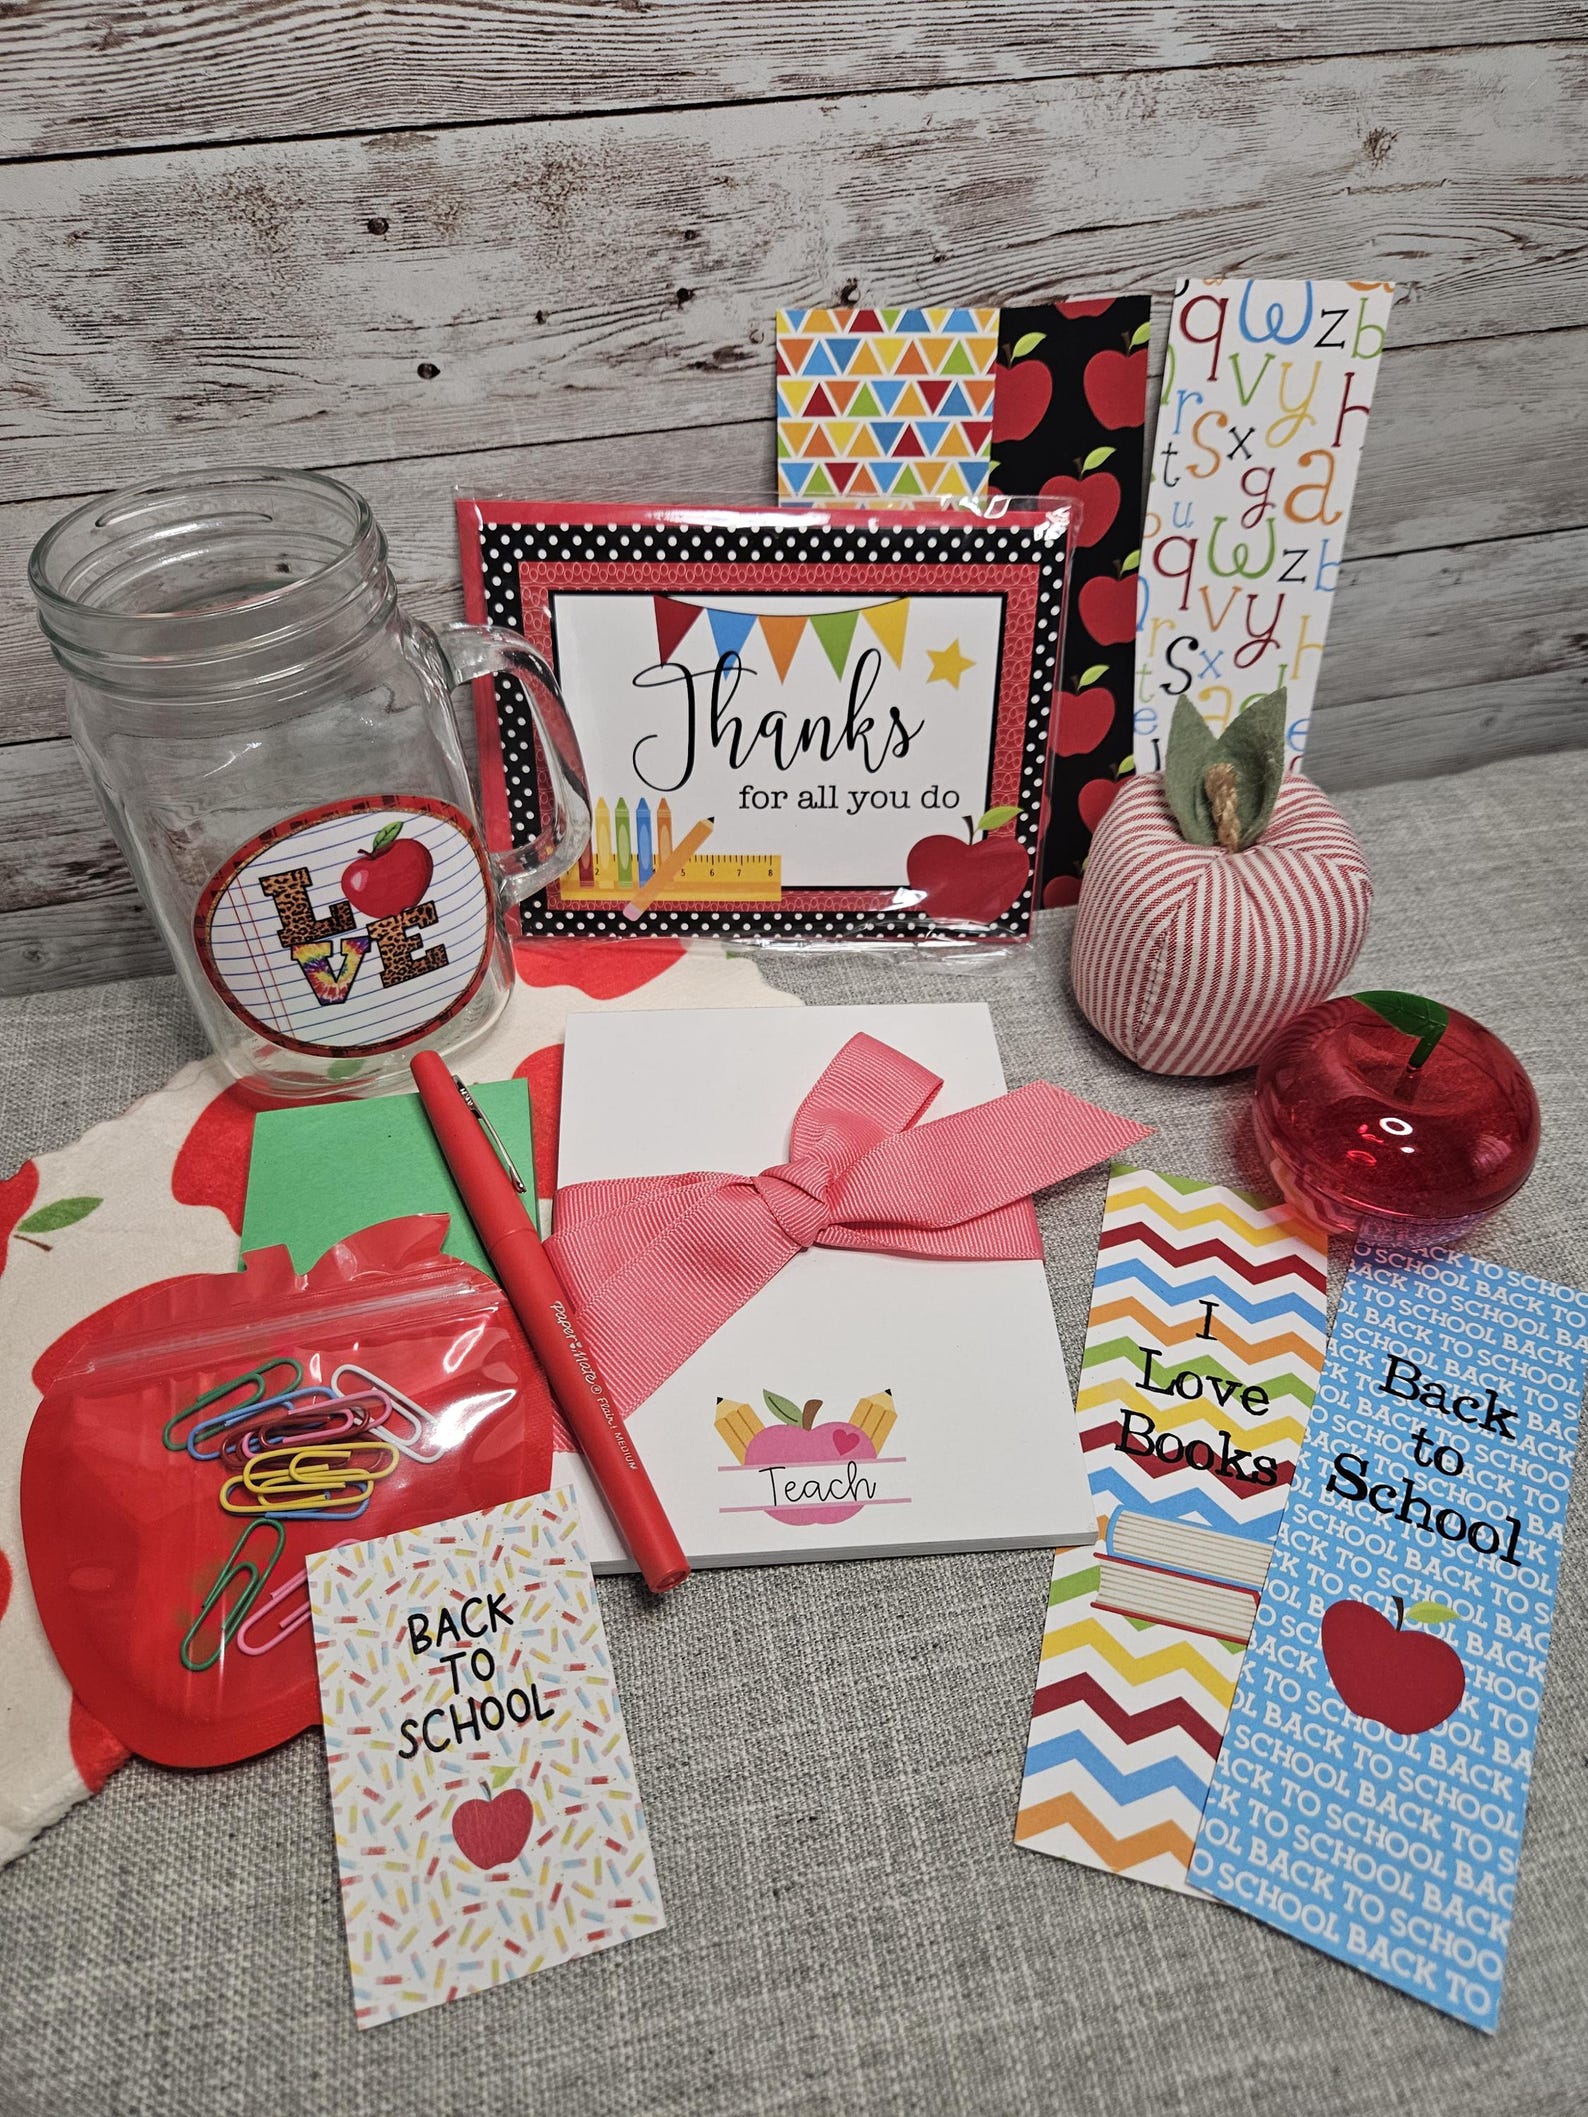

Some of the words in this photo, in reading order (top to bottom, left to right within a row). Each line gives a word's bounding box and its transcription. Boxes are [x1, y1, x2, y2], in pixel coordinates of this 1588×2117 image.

[1179, 294, 1229, 382] q
[1313, 308, 1350, 349] z
[1351, 297, 1386, 359] b
[1172, 388, 1204, 435] r
[1228, 352, 1276, 406] v
[1265, 360, 1322, 448] y
[1161, 441, 1181, 488] t
[1226, 426, 1256, 461] x
[1171, 501, 1194, 529] u
[1283, 449, 1343, 526] a
[1153, 535, 1198, 611] q
[1277, 549, 1309, 584] z
[1147, 617, 1176, 659] r
[1198, 585, 1243, 633] v
[1233, 592, 1285, 669] y
[1135, 663, 1155, 703] t
[1197, 650, 1224, 679] x
[632, 648, 925, 792] Thanks
[1133, 707, 1158, 735] e
[738, 785, 788, 810] for
[797, 785, 839, 810] all
[847, 789, 911, 816] you
[920, 785, 960, 810] do
[680, 869, 686, 877] 5
[709, 869, 715, 877] 6
[737, 869, 742, 877] 7
[768, 869, 774, 877] 8
[1375, 1249, 1469, 1291] SCHOOL
[1475, 1280, 1544, 1315] BACK
[1551, 1304, 1585, 1328] TO
[1470, 1257, 1503, 1279] TO
[1195, 1299, 1219, 1341] I
[1363, 1284, 1395, 1307] TO
[1399, 1300, 1496, 1344] SCHOOL
[1502, 1333, 1573, 1371] BACK
[1415, 1281, 1447, 1304] TO
[1451, 1296, 1549, 1340] SCHOOL
[1135, 1346, 1271, 1417] Love
[1341, 1323, 1438, 1370] SCHOOL
[1444, 1358, 1515, 1398] BACK
[1523, 1386, 1558, 1411] TO
[1355, 1372, 1388, 1397] TO
[1364, 1307, 1432, 1345] BACK
[1439, 1334, 1473, 1358] TO
[1477, 1350, 1580, 1396] SCHOOL
[1357, 1397, 1428, 1434] BACK
[1435, 1426, 1470, 1454] TO
[1378, 1353, 1519, 1440] Back
[1114, 1408, 1278, 1487] Books
[1411, 1427, 1465, 1477] to
[758, 1460, 877, 1507] Teach
[1325, 1453, 1523, 1567] School
[1374, 1453, 1409, 1482] TO
[1413, 1472, 1517, 1525] SCHOOL
[1522, 1485, 1560, 1513] TO
[1293, 1504, 1398, 1562] SCHOOL
[1405, 1547, 1482, 1597] BACK
[1491, 1582, 1529, 1613] TO
[1319, 1484, 1392, 1531] BACK
[1401, 1522, 1436, 1547] TO
[1441, 1538, 1552, 1595] SCHOOL
[1307, 1563, 1343, 1594] TO
[1466, 1631, 1547, 1683] BACK
[1336, 1547, 1372, 1578] TO
[1376, 1567, 1488, 1629] SCHOOL
[407, 1592, 514, 1656] BACK
[440, 1647, 495, 1695] TO
[397, 1683, 556, 1760] SCHOOL
[1264, 1667, 1301, 1702] TO
[1306, 1691, 1421, 1760] SCHOOL
[1429, 1743, 1512, 1801] BACK
[1488, 1703, 1528, 1738] TO
[1234, 1725, 1350, 1797] SCHOOL
[1357, 1779, 1442, 1840] BACK
[1451, 1822, 1492, 1861] TO
[1263, 1701, 1344, 1759] BACK
[1353, 1742, 1392, 1779] TO
[1398, 1767, 1519, 1838] SCHOOL
[1281, 1778, 1320, 1816] TO
[1326, 1804, 1447, 1879] SCHOOL
[1248, 1836, 1334, 1900] BACK
[1343, 1882, 1384, 1923] TO
[1249, 1798, 1288, 1837] TO
[1294, 1825, 1414, 1901] SCHOOL
[1423, 1882, 1511, 1946] BACK
[1218, 1863, 1339, 1943] SCHOOL
[1347, 1923, 1436, 1990] BACK
[1446, 1971, 1490, 2014] TO
